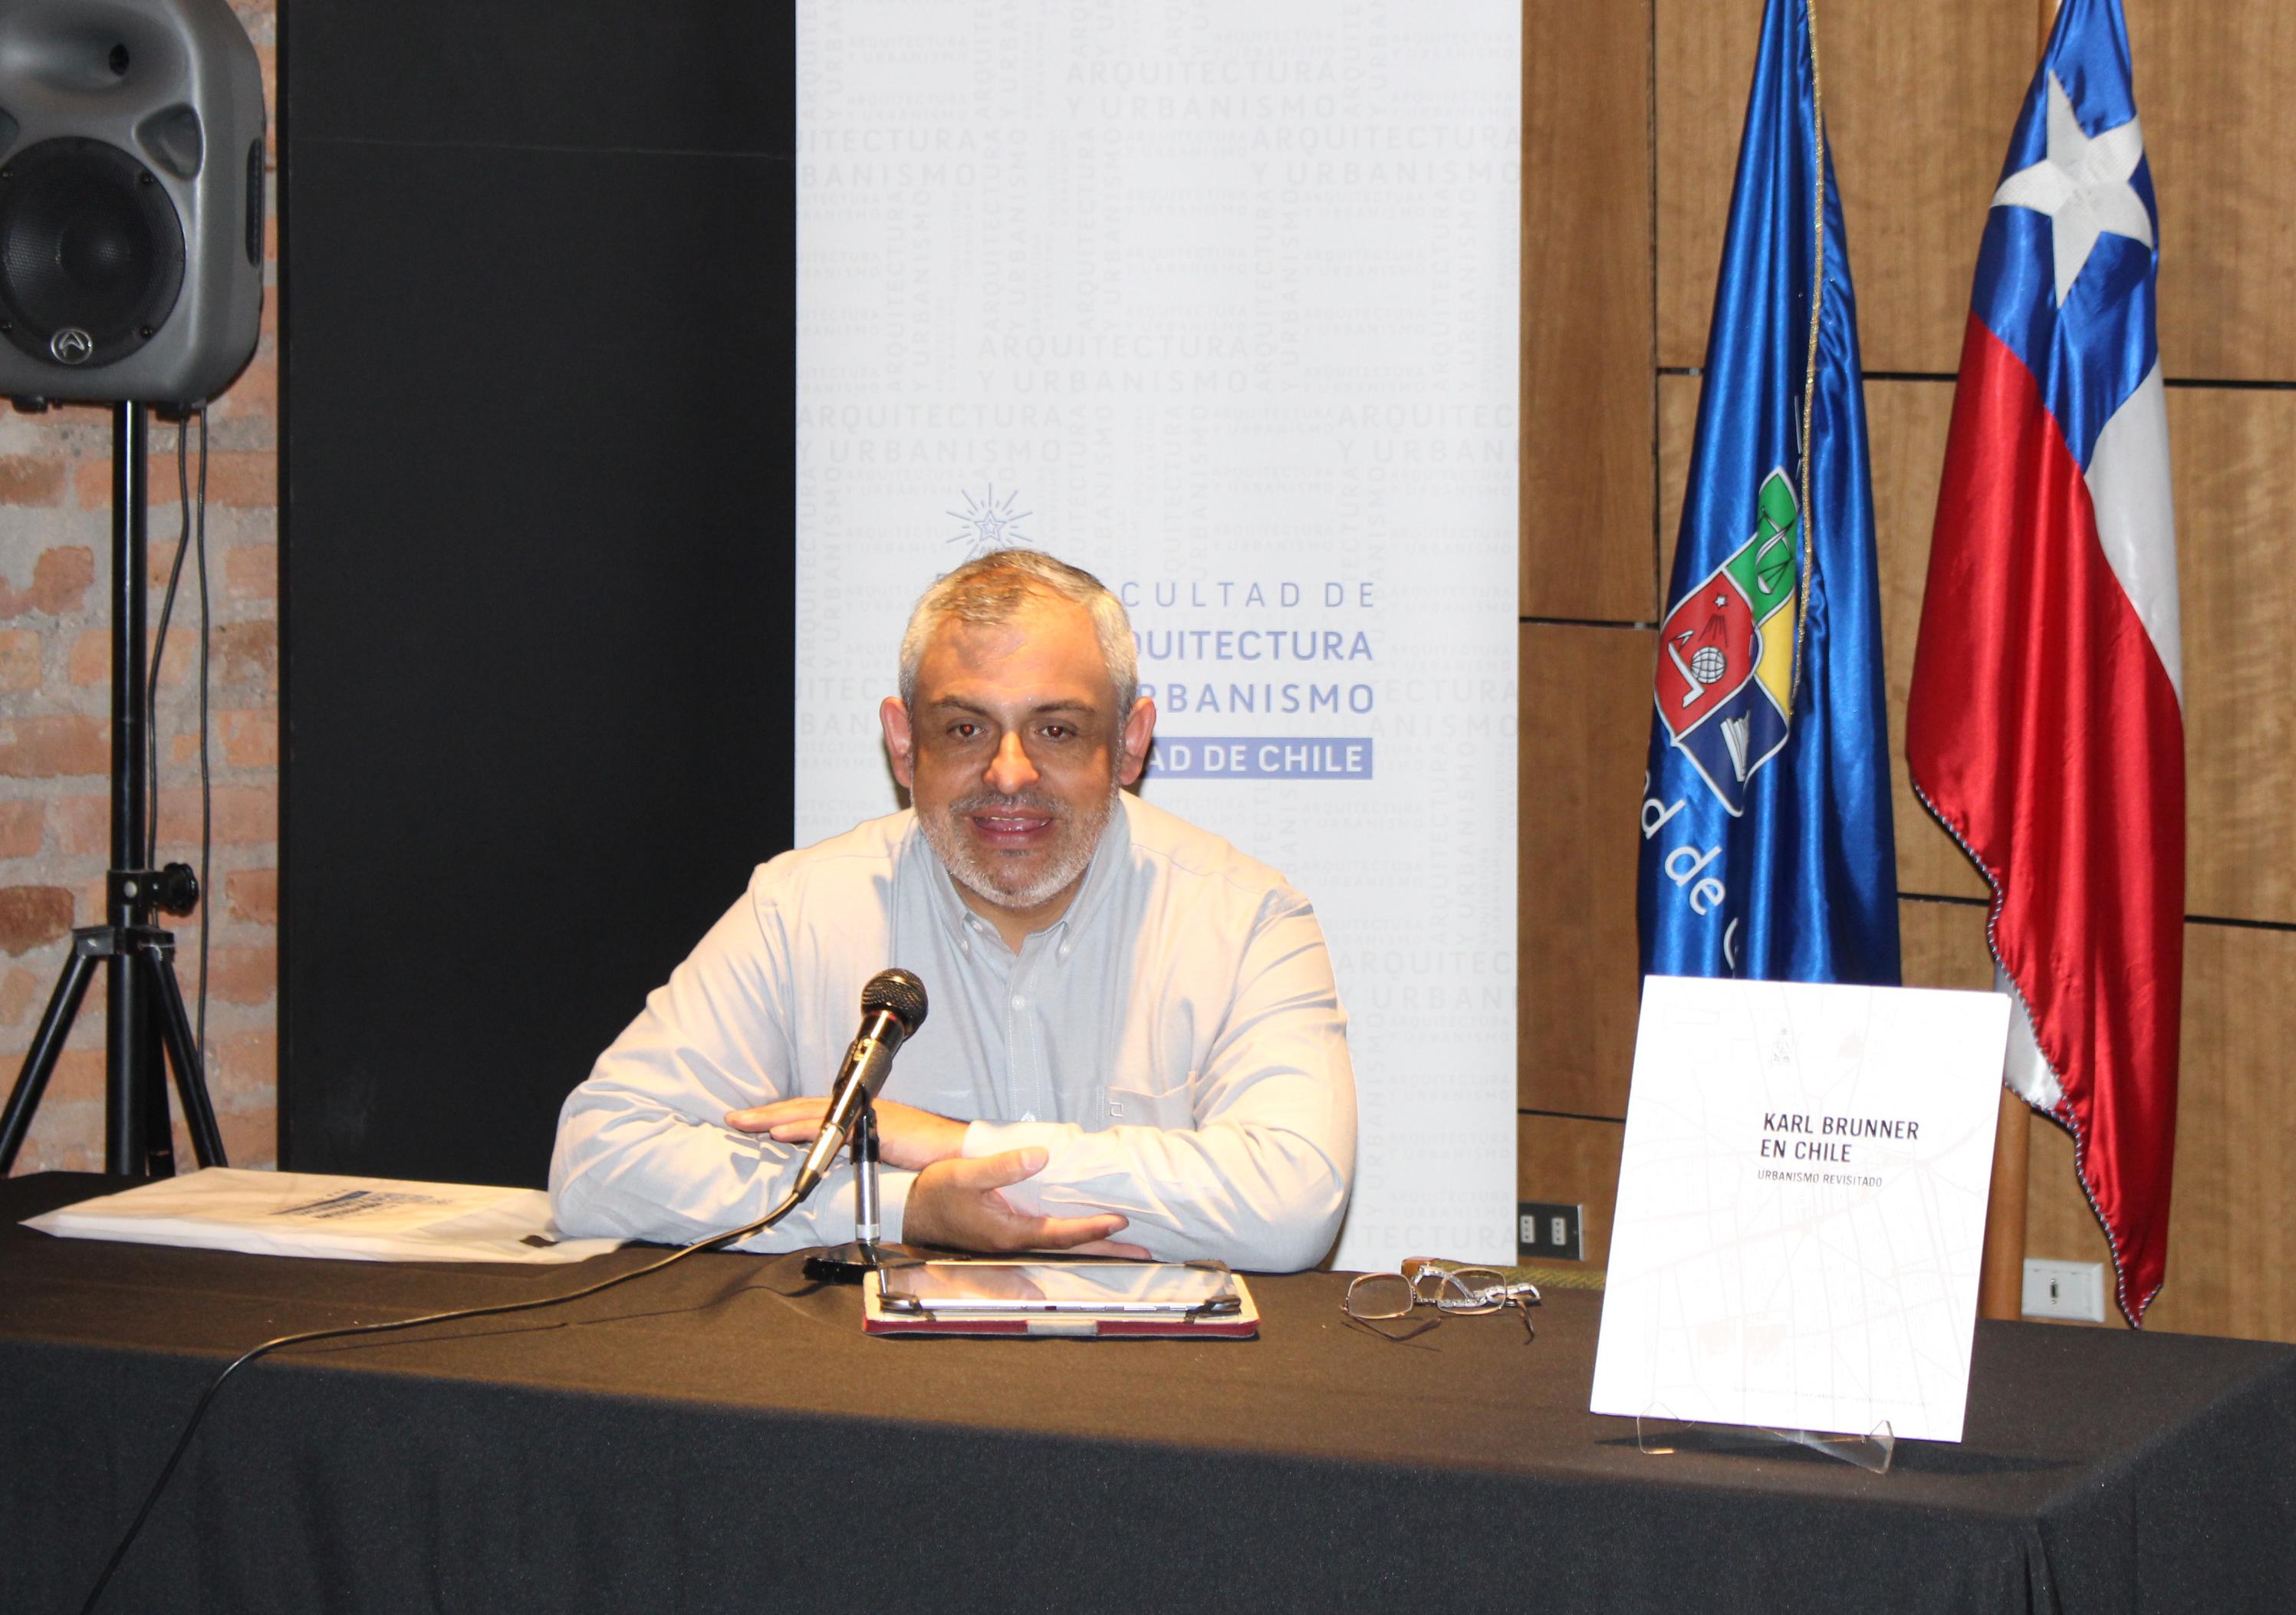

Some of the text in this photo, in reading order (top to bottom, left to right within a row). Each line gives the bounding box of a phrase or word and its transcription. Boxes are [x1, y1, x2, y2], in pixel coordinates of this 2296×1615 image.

[1064, 60, 1336, 90] ARQUITECTURA
[1064, 94, 1334, 120] Y URBANISMO
[1252, 125, 1518, 156] ARQUITECTURA
[802, 163, 976, 189] BANISMO
[1252, 160, 1518, 186] Y URBANISMO
[979, 334, 1248, 365] ARQUITECTURA
[978, 370, 1247, 393] Y URBANISMO
[799, 405, 1061, 435] ARQUITECTURA
[830, 439, 1061, 463] URBANISMO
[1337, 439, 1355, 462] Y
[1120, 581, 1374, 608] CULTAD DE
[1131, 630, 1373, 661] UITECTURA
[1135, 683, 1374, 714] BANISMO
[1370, 714, 1517, 738] ANISMO
[1150, 745, 1190, 771] AD
[1203, 745, 1247, 772] DE
[1258, 745, 1363, 772] CHILE
[1665, 846, 1725, 916] de
[1763, 1113, 1919, 1140] KARL BRUNNER
[1760, 1139, 1852, 1163] EN CHILE
[1758, 1169, 1883, 1188] URBANISMO REVISITADO
